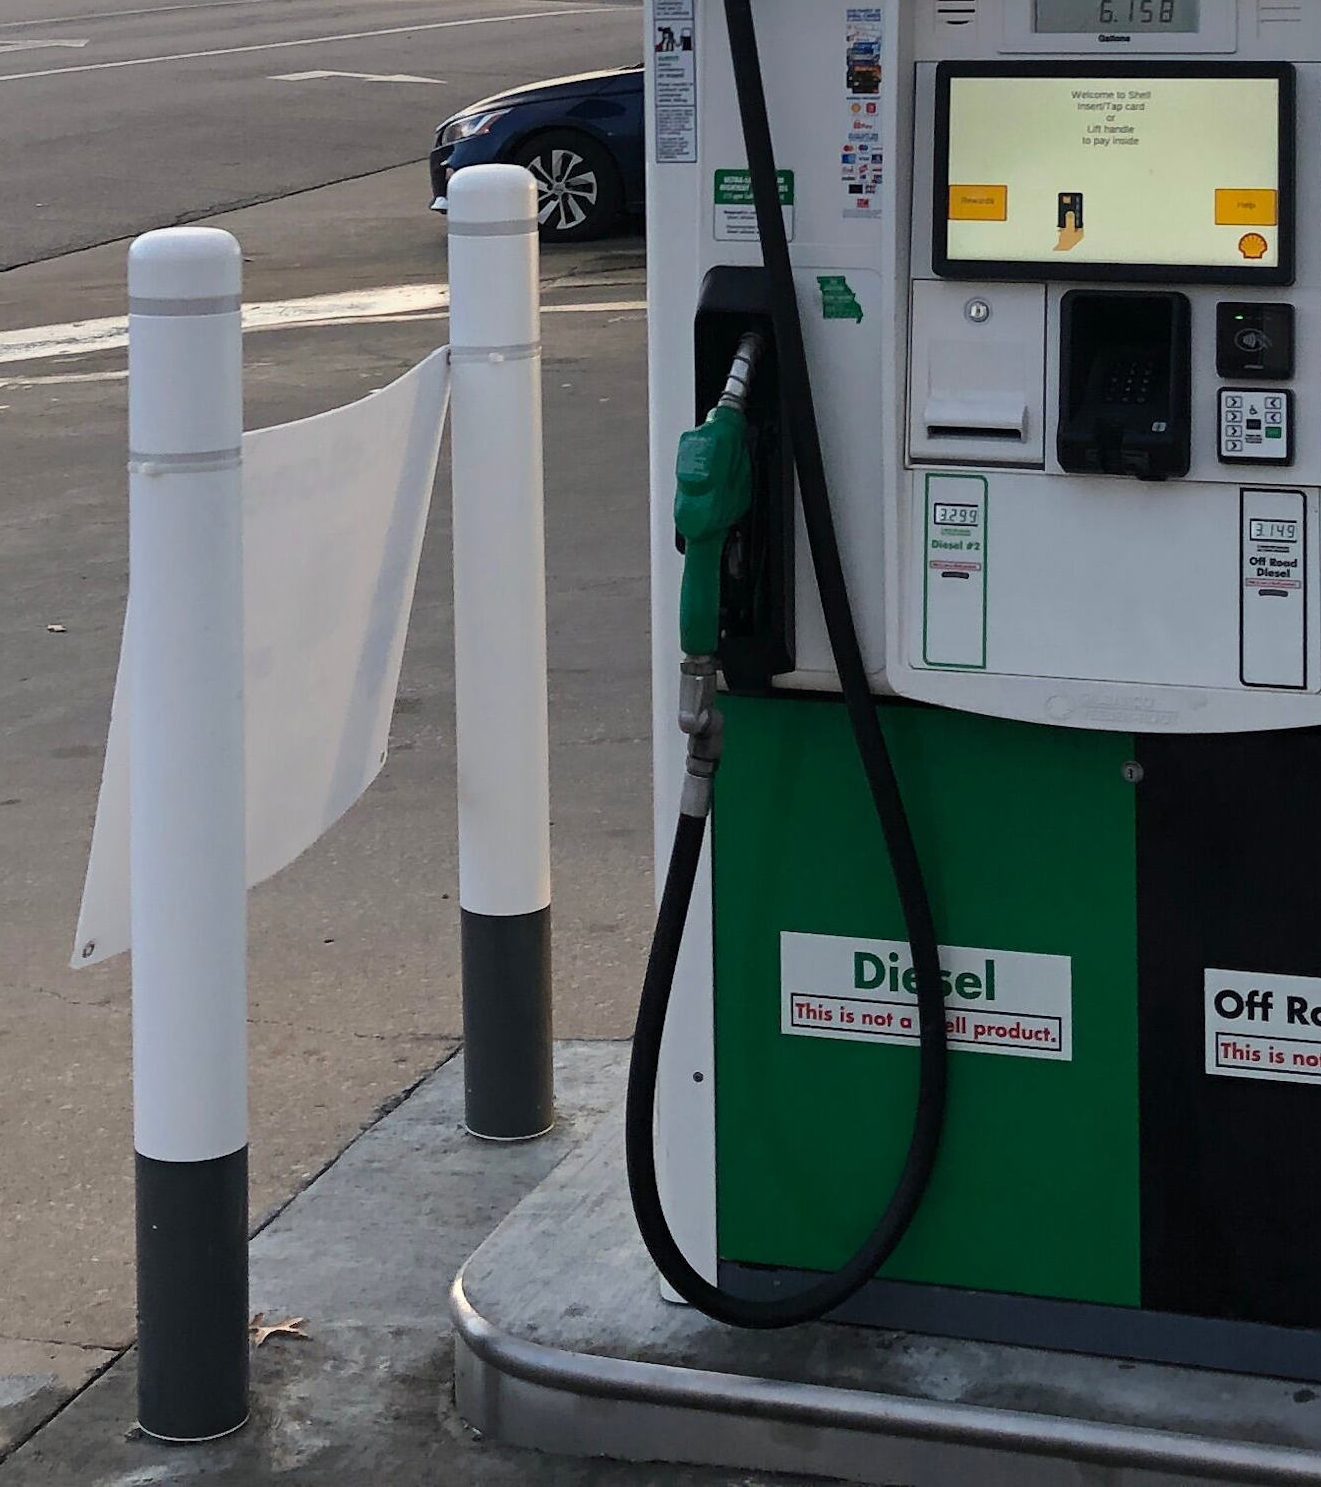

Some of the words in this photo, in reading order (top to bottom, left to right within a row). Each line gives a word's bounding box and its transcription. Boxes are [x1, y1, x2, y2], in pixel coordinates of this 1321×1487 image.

[1099, 0, 1174, 24] 6.158
[1098, 35, 1131, 43] Gallons
[1071, 91, 1115, 99] Welcome
[1116, 91, 1126, 99] to
[1128, 91, 1151, 99] Shell
[1125, 103, 1145, 111] card
[1087, 125, 1101, 133] Lift
[1104, 125, 1134, 133] handle
[1082, 137, 1091, 145] to
[1093, 138, 1110, 147] pay
[1112, 137, 1139, 145] inside
[931, 540, 963, 550] Diesel
[966, 542, 981, 550] #2
[1249, 557, 1266, 566] Off
[1270, 558, 1297, 568] Road
[1257, 568, 1291, 578] Diesel
[854, 951, 996, 1001] Diesel
[1214, 989, 1274, 1022] Off
[795, 1002, 833, 1022] This
[839, 1006, 855, 1024] is
[861, 1013, 894, 1029] not
[900, 1017, 913, 1030] a
[973, 1021, 1057, 1043] product.
[1220, 1042, 1262, 1062] This
[1268, 1045, 1285, 1065] is
